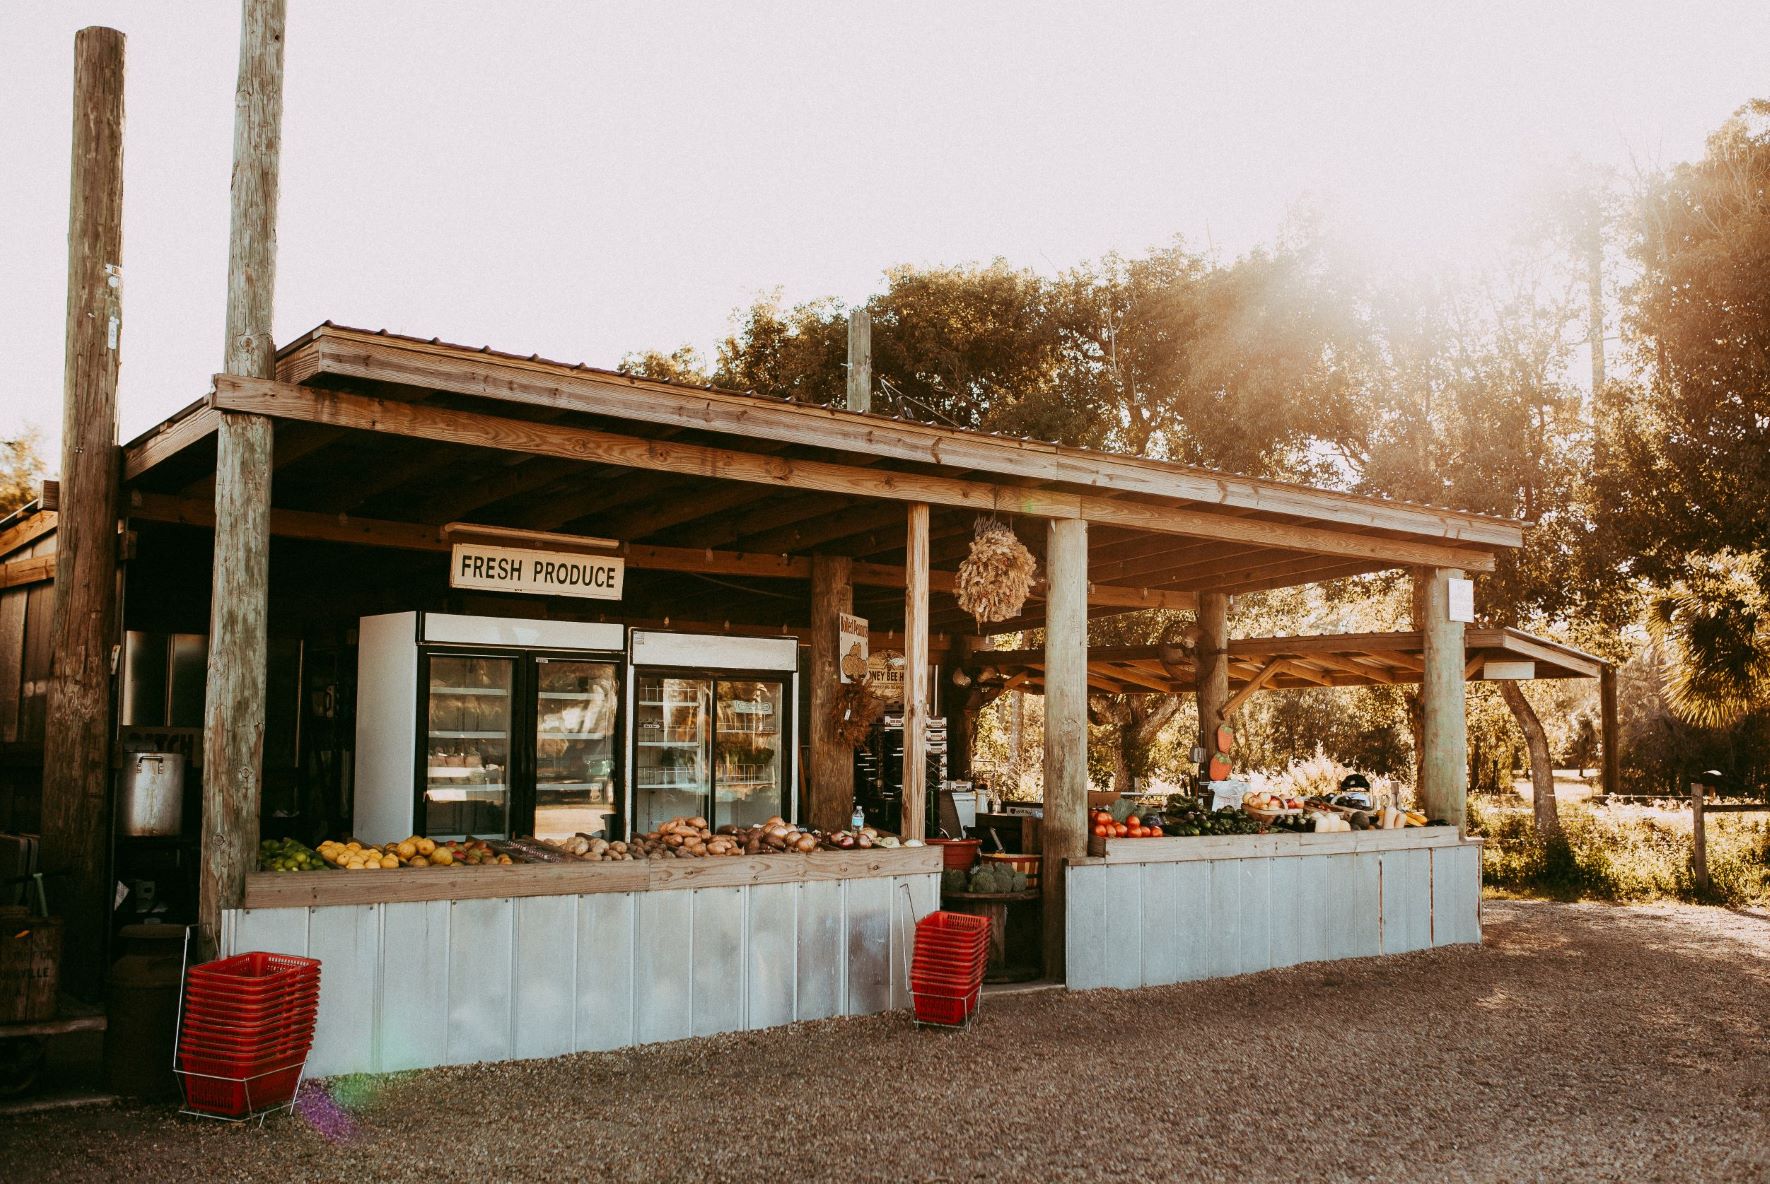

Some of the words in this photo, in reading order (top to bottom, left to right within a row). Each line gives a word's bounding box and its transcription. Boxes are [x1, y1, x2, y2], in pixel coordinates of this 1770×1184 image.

[461, 555, 522, 581] FRESH
[533, 561, 616, 588] PRODUCE
[886, 671, 898, 681] BEE
